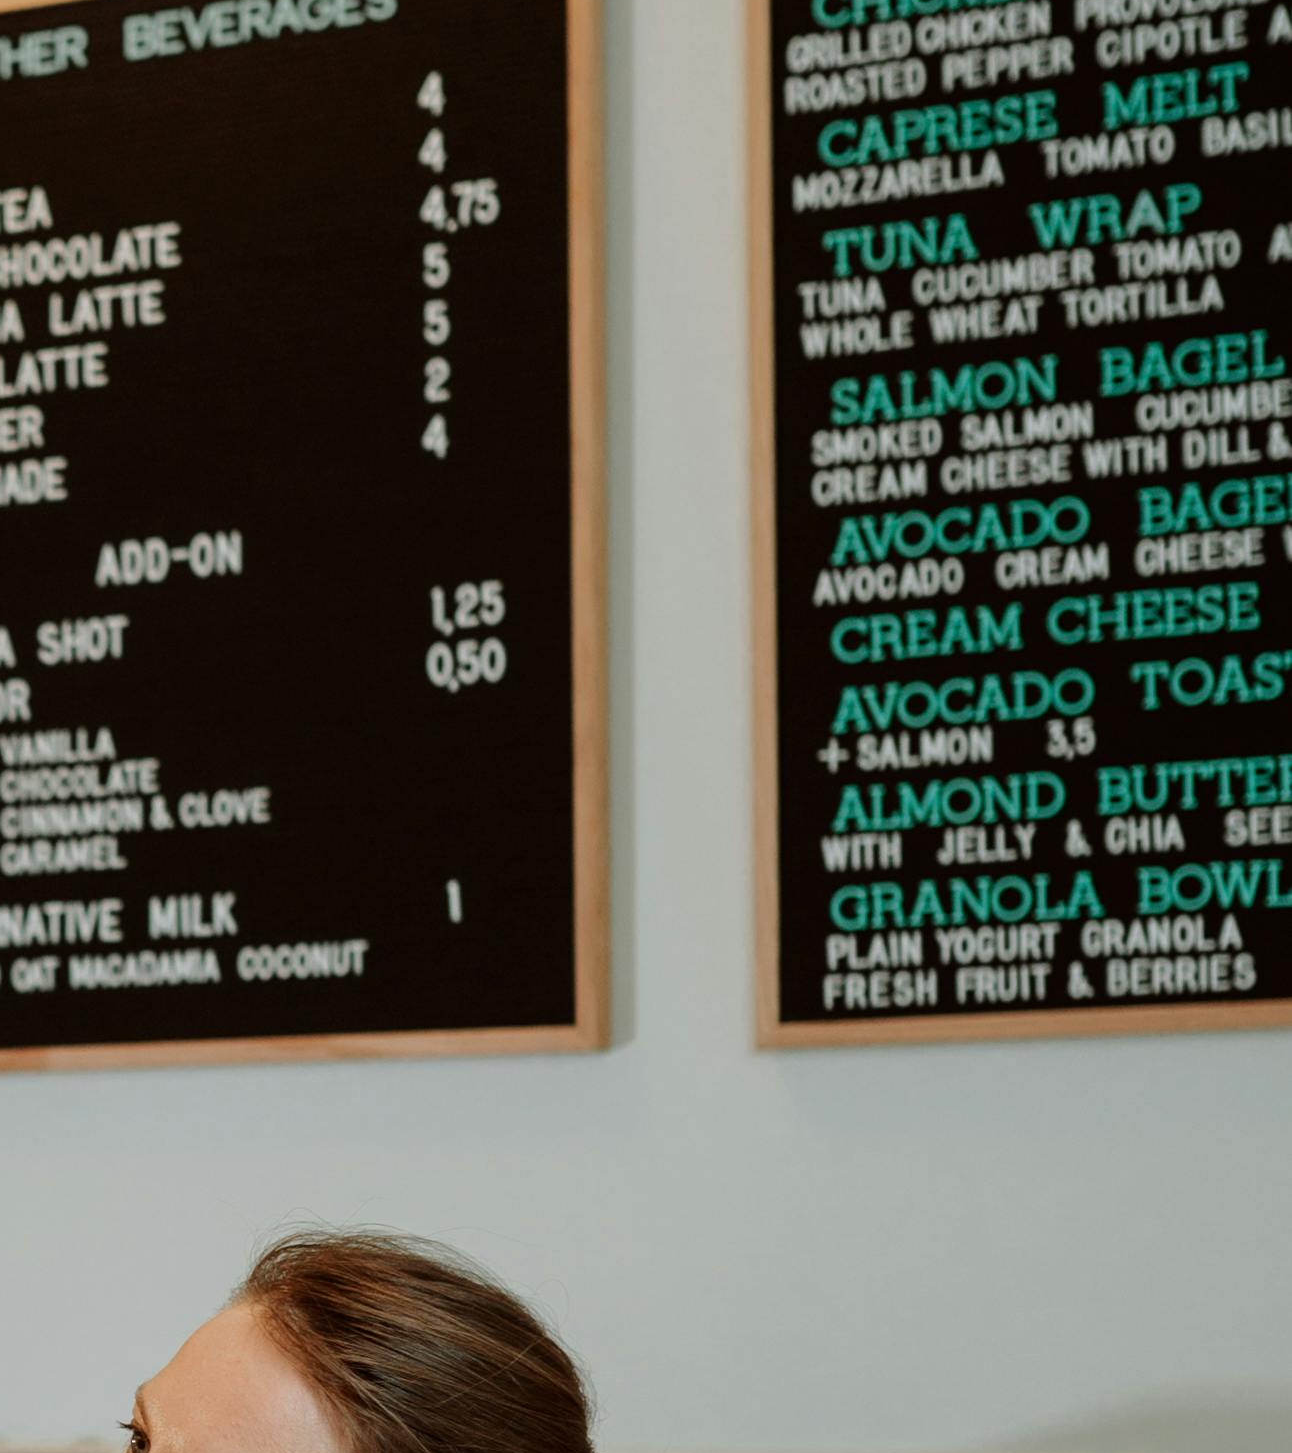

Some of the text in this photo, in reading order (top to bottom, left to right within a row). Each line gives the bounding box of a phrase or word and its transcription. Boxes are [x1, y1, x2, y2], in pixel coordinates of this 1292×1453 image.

[916, 0, 1050, 54] CHICKEN
[418, 71, 445, 115] 4
[785, 59, 926, 113] ROASTED
[942, 37, 1074, 90] PEPPER
[820, 63, 1248, 166] CAPRESE MELT
[419, 128, 446, 172] 4
[793, 151, 1003, 211] MOZZARELLA
[1043, 125, 1175, 176] TOMATO
[823, 184, 1200, 277] TUNA WRAP
[49, 280, 165, 336] LATTE
[423, 243, 450, 288] 5
[799, 277, 885, 318] TUNA
[913, 249, 1094, 305] CUCUMBER
[1116, 230, 1241, 279] TOMATO
[424, 300, 450, 345] 5
[800, 276, 1223, 358] WHOLE WHEAT TORTILLA
[424, 357, 450, 403] 2
[832, 331, 1285, 424] SALMON BAGEL
[422, 415, 449, 458] 4
[812, 418, 942, 467] SMOKED
[961, 402, 1093, 451] SALMON
[812, 461, 927, 507] CREAM
[941, 444, 1070, 493] CHEESE
[1083, 435, 1167, 477] WITH
[1183, 427, 1260, 468] DILL
[832, 473, 1292, 566] AVOCADO BAGE
[96, 531, 242, 586] ADD-ON
[814, 557, 964, 605] AVOCADO
[995, 543, 1109, 589] CREAM
[1136, 527, 1263, 576] CHEESE
[37, 615, 129, 665] SHOT
[831, 583, 1260, 663] CREAM CHEESE
[833, 669, 1094, 734] AVOCADO
[179, 787, 270, 828] CLOVE
[834, 772, 1064, 832] ALMOND
[0, 835, 126, 876] CARAMEL
[821, 832, 901, 871] WITH
[938, 823, 1035, 864] JELLY
[1105, 815, 1184, 854] CHIA
[149, 893, 237, 939] MILK
[830, 872, 1103, 931] GRANOLA
[237, 939, 368, 980] COCONUT
[827, 931, 922, 970] PLAIN
[1082, 915, 1241, 957] GRANOLA
[823, 970, 937, 1009] FRESH
[957, 964, 1050, 1003] FRUIT
[1107, 954, 1256, 996] BERRIES
